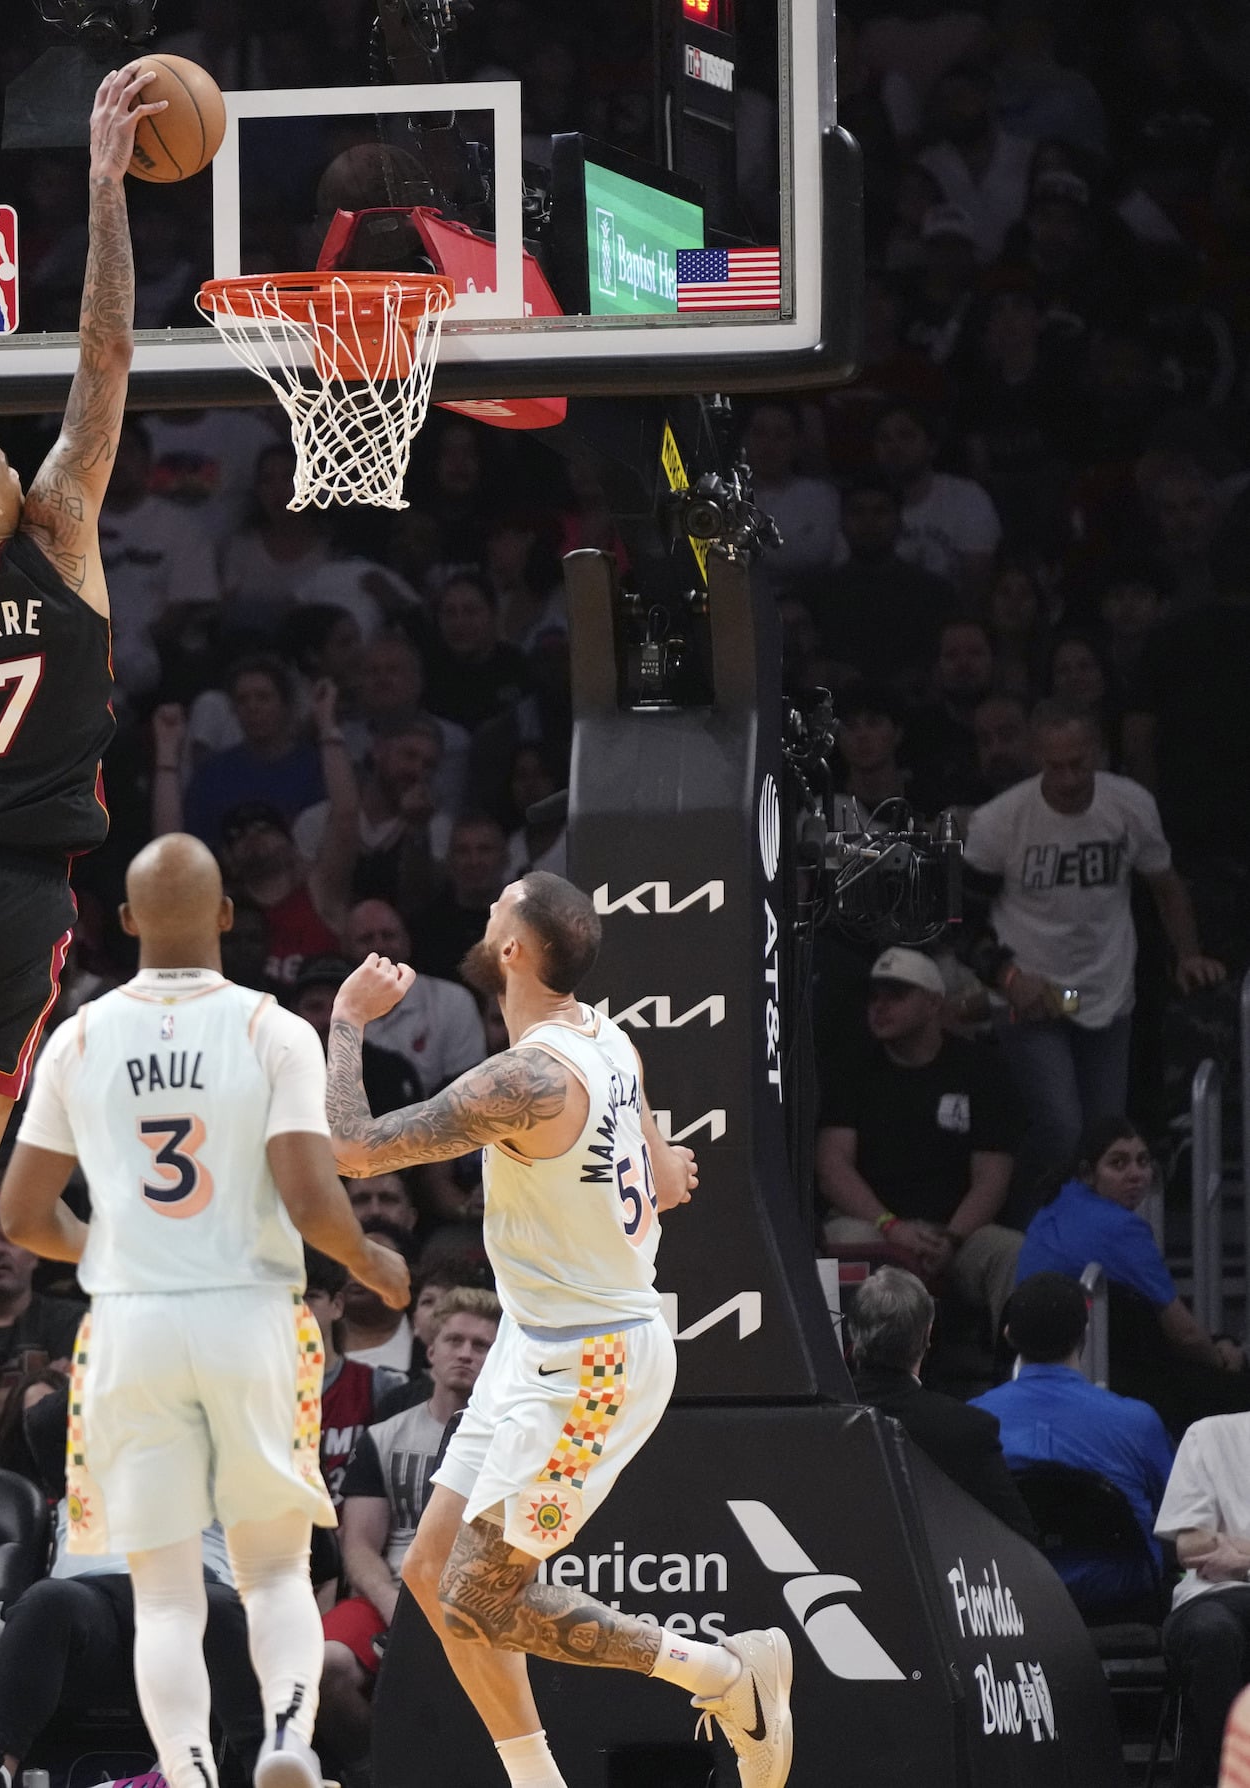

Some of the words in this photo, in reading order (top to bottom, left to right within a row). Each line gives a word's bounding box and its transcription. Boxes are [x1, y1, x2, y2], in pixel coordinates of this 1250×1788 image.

[616, 234, 657, 301] Baptist
[593, 880, 725, 914] KIA
[764, 898, 783, 1104] AT&T
[126, 1051, 205, 1097] PAUL
[137, 1113, 215, 1220] 3
[538, 1541, 729, 1593] erican
[947, 1556, 1025, 1638] Florida
[974, 1652, 1023, 1736] Blue
